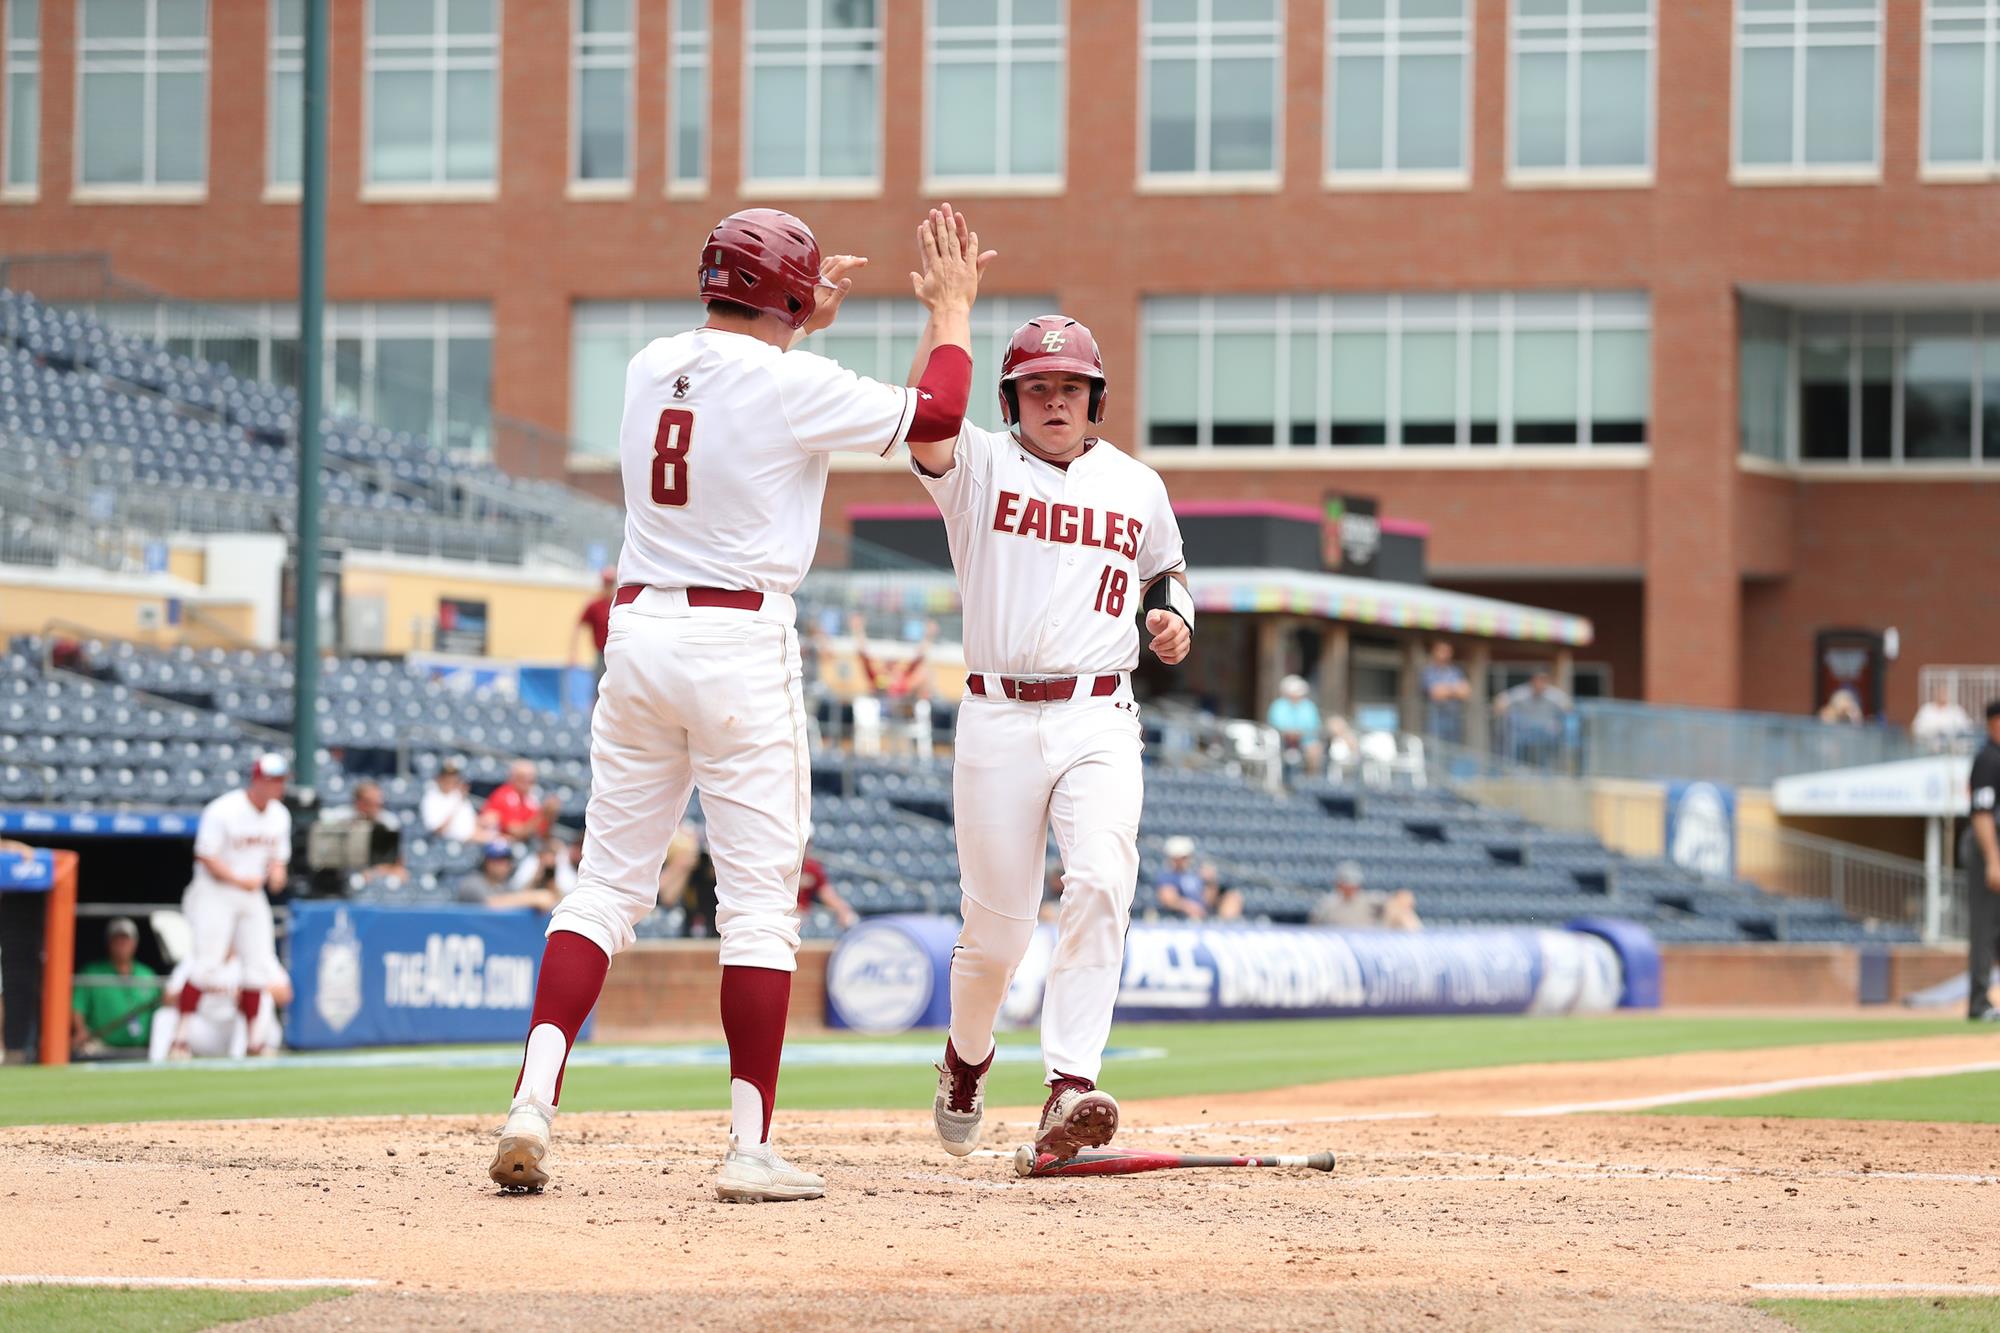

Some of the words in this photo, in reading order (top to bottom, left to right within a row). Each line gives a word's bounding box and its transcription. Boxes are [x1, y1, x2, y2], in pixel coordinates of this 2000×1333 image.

[1041, 330, 1066, 353] BC
[651, 407, 696, 507] 8
[992, 489, 1144, 562] EAGLES
[1093, 564, 1129, 618] 18
